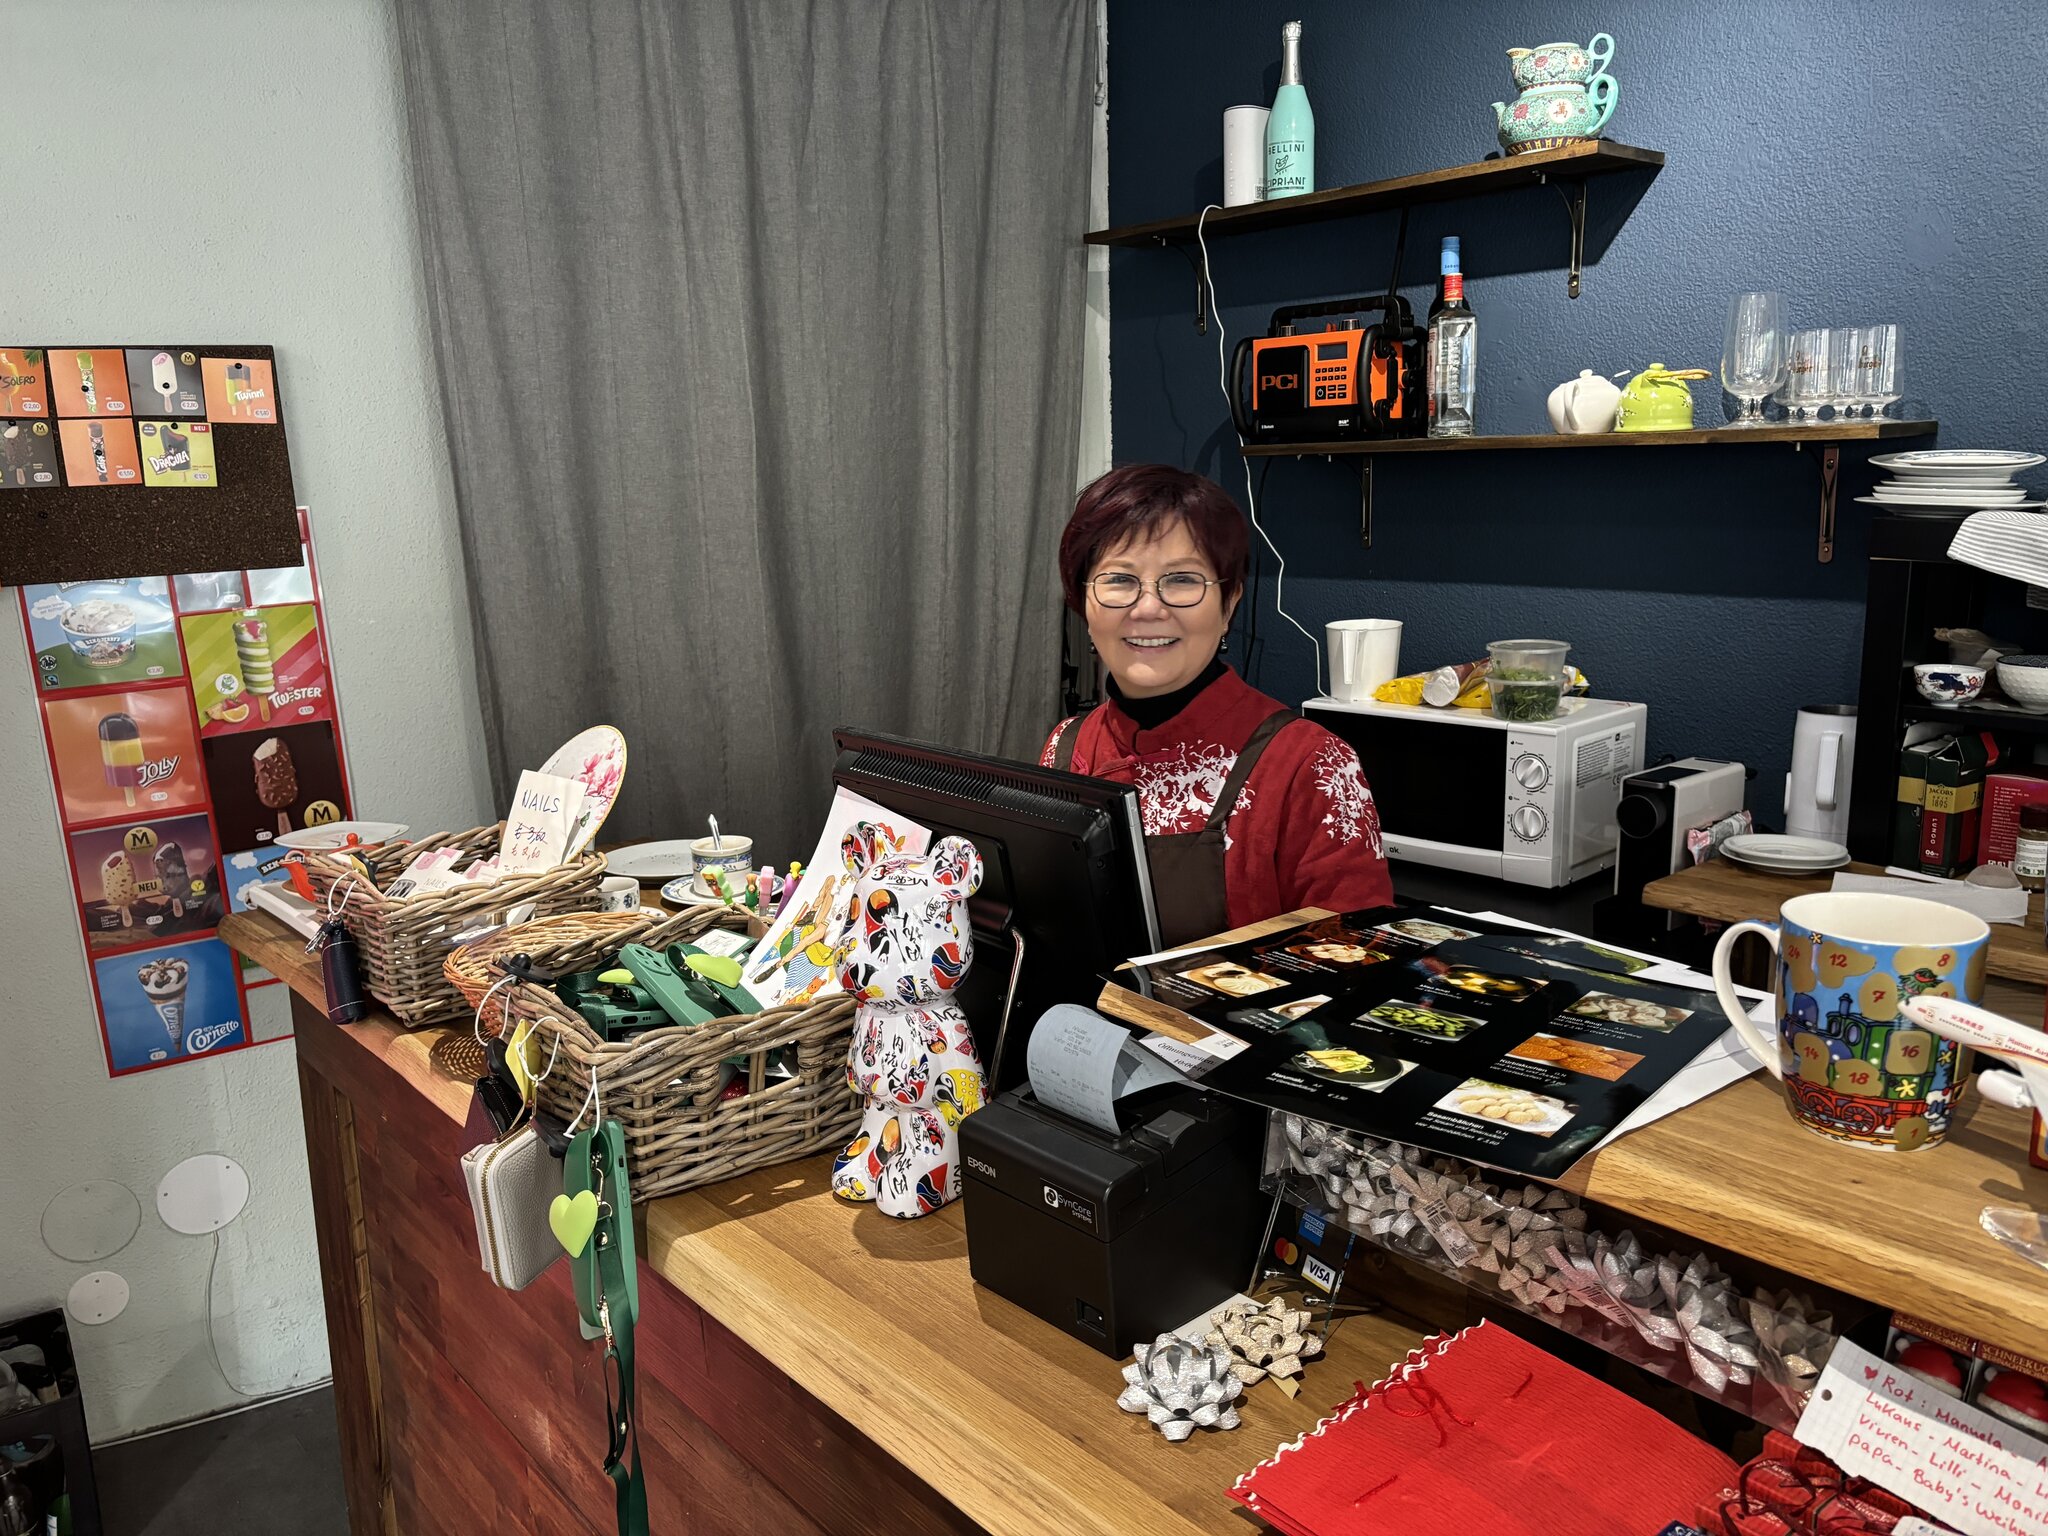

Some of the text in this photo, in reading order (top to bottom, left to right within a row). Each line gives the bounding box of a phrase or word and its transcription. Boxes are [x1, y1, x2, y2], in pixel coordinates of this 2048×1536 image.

[2, 375, 36, 388] SOLERO
[1261, 374, 1298, 391] PCI
[234, 389, 265, 400] Twinni
[149, 450, 190, 472] DRACULA
[136, 756, 180, 788] JOLLY
[1928, 788, 1954, 796] JACOBS
[522, 789, 560, 813] NAILS
[1931, 799, 1948, 809] 1895
[138, 881, 158, 893] NEU
[1788, 944, 1800, 959] 24
[1829, 952, 1848, 968] 12
[1937, 953, 1950, 967] 8
[1872, 990, 1887, 1003] 7
[187, 1020, 239, 1055] Cornetto
[1803, 1046, 1819, 1060] 14
[1901, 1044, 1920, 1059] 16
[1848, 1071, 1869, 1085] 18
[1425, 1111, 1486, 1129] Sesambällchen
[1910, 1127, 1919, 1139] 1
[967, 1155, 997, 1179] EPSON
[1058, 1194, 1092, 1218] SynCore
[1309, 1260, 1331, 1285] VISA
[1881, 1375, 1914, 1403] Rot
[1935, 1407, 2003, 1452] Manuela
[1929, 1452, 1967, 1478] Lilli
[1943, 1437, 2011, 1481] Martina
